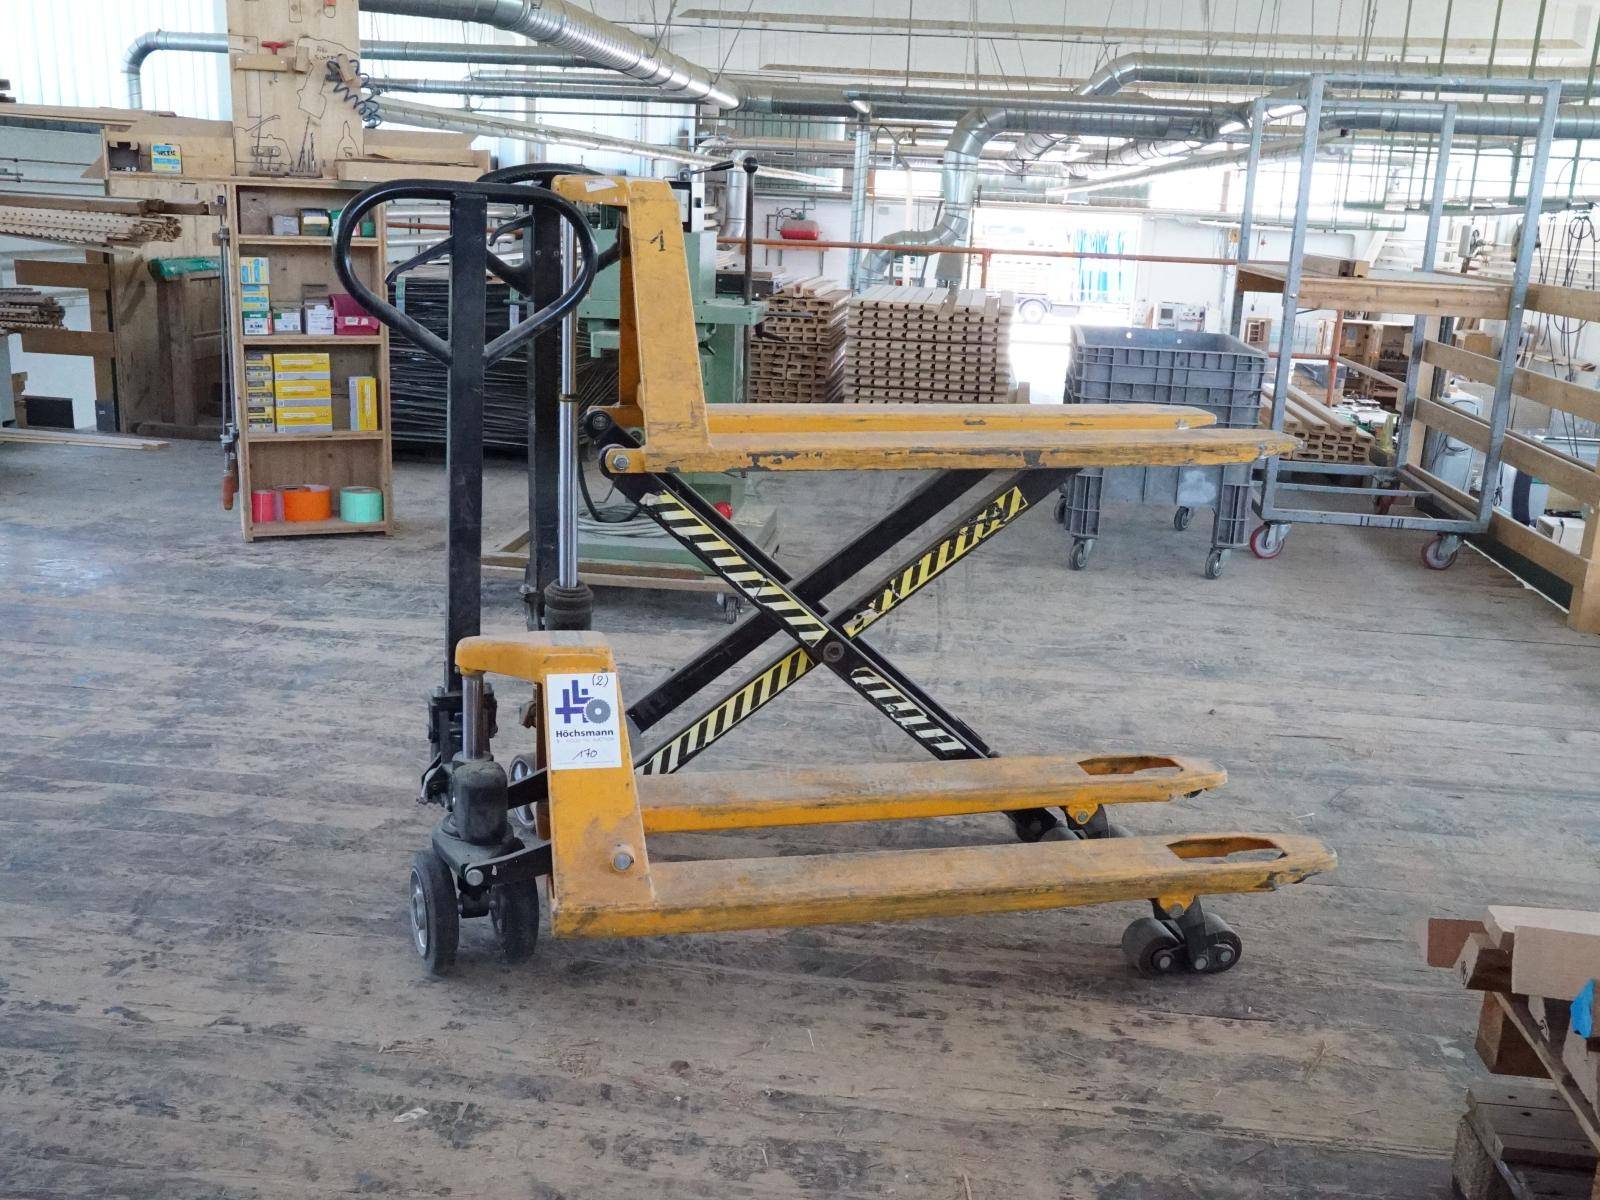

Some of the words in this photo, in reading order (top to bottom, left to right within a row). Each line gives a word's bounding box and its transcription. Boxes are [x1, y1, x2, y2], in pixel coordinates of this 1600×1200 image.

[649, 229, 666, 252] 1
[592, 673, 609, 687] (2)
[555, 729, 614, 738] Höchsmann
